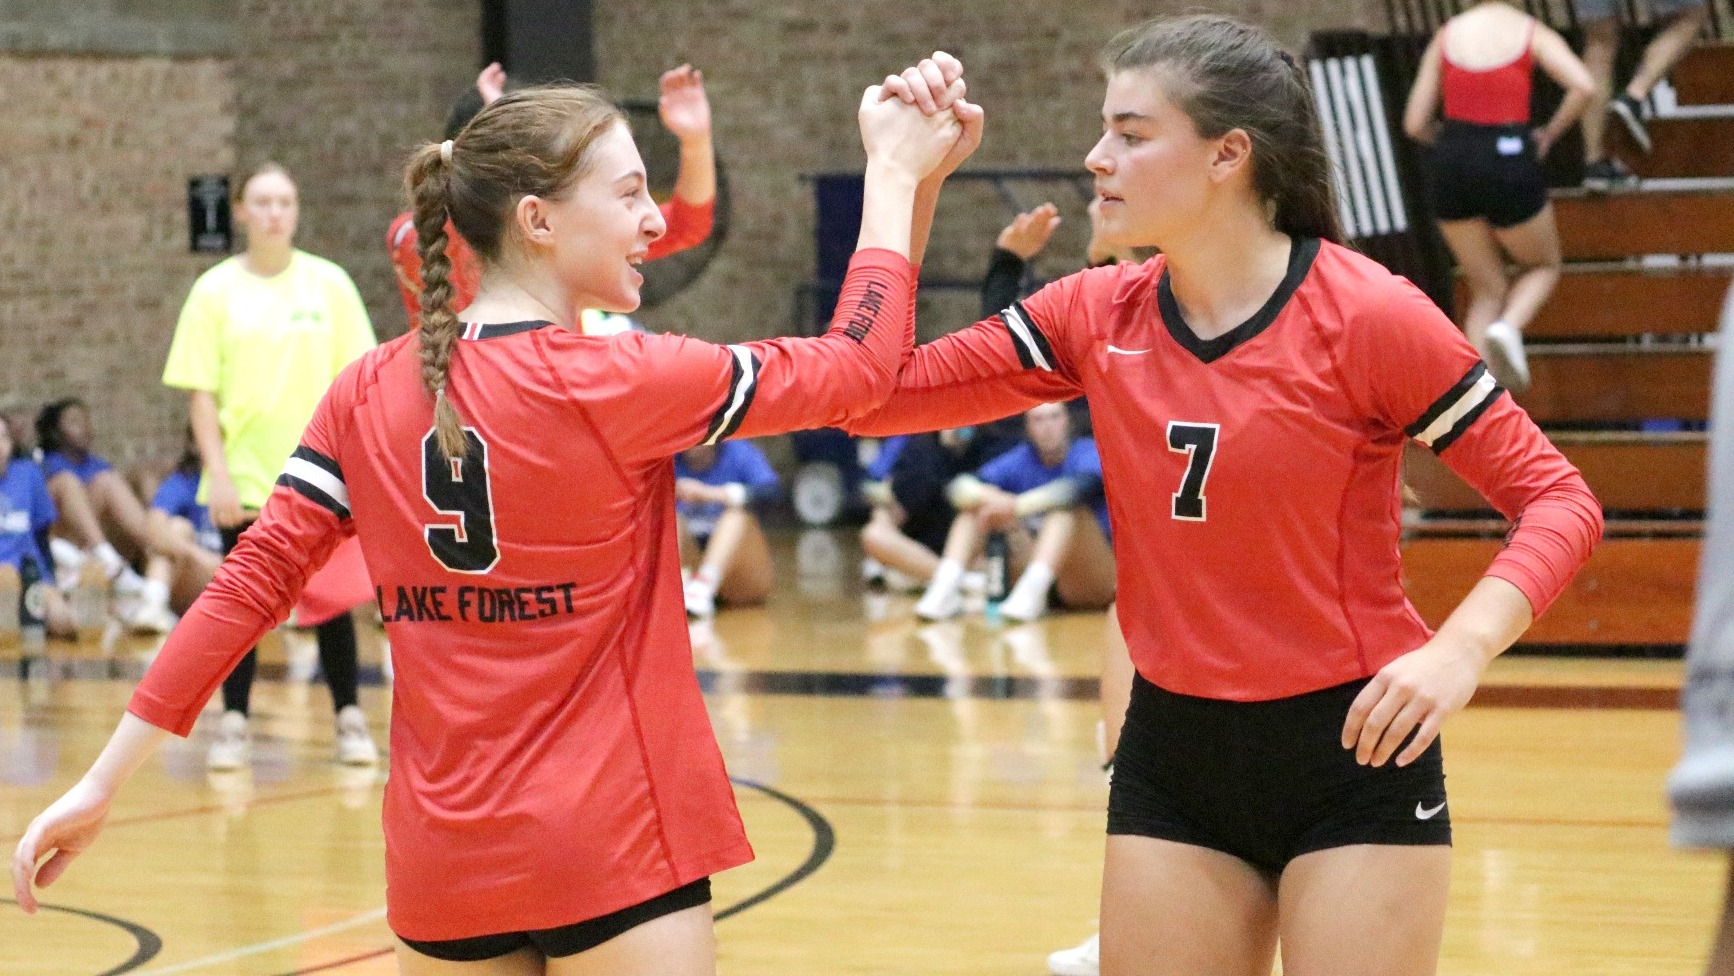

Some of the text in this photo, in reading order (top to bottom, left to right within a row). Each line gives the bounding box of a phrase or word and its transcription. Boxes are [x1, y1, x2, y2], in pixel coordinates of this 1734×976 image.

[857, 281, 888, 317] LAKE
[421, 426, 501, 574] 9
[1166, 420, 1220, 521] 7
[376, 582, 576, 623] LAKE FOREST
